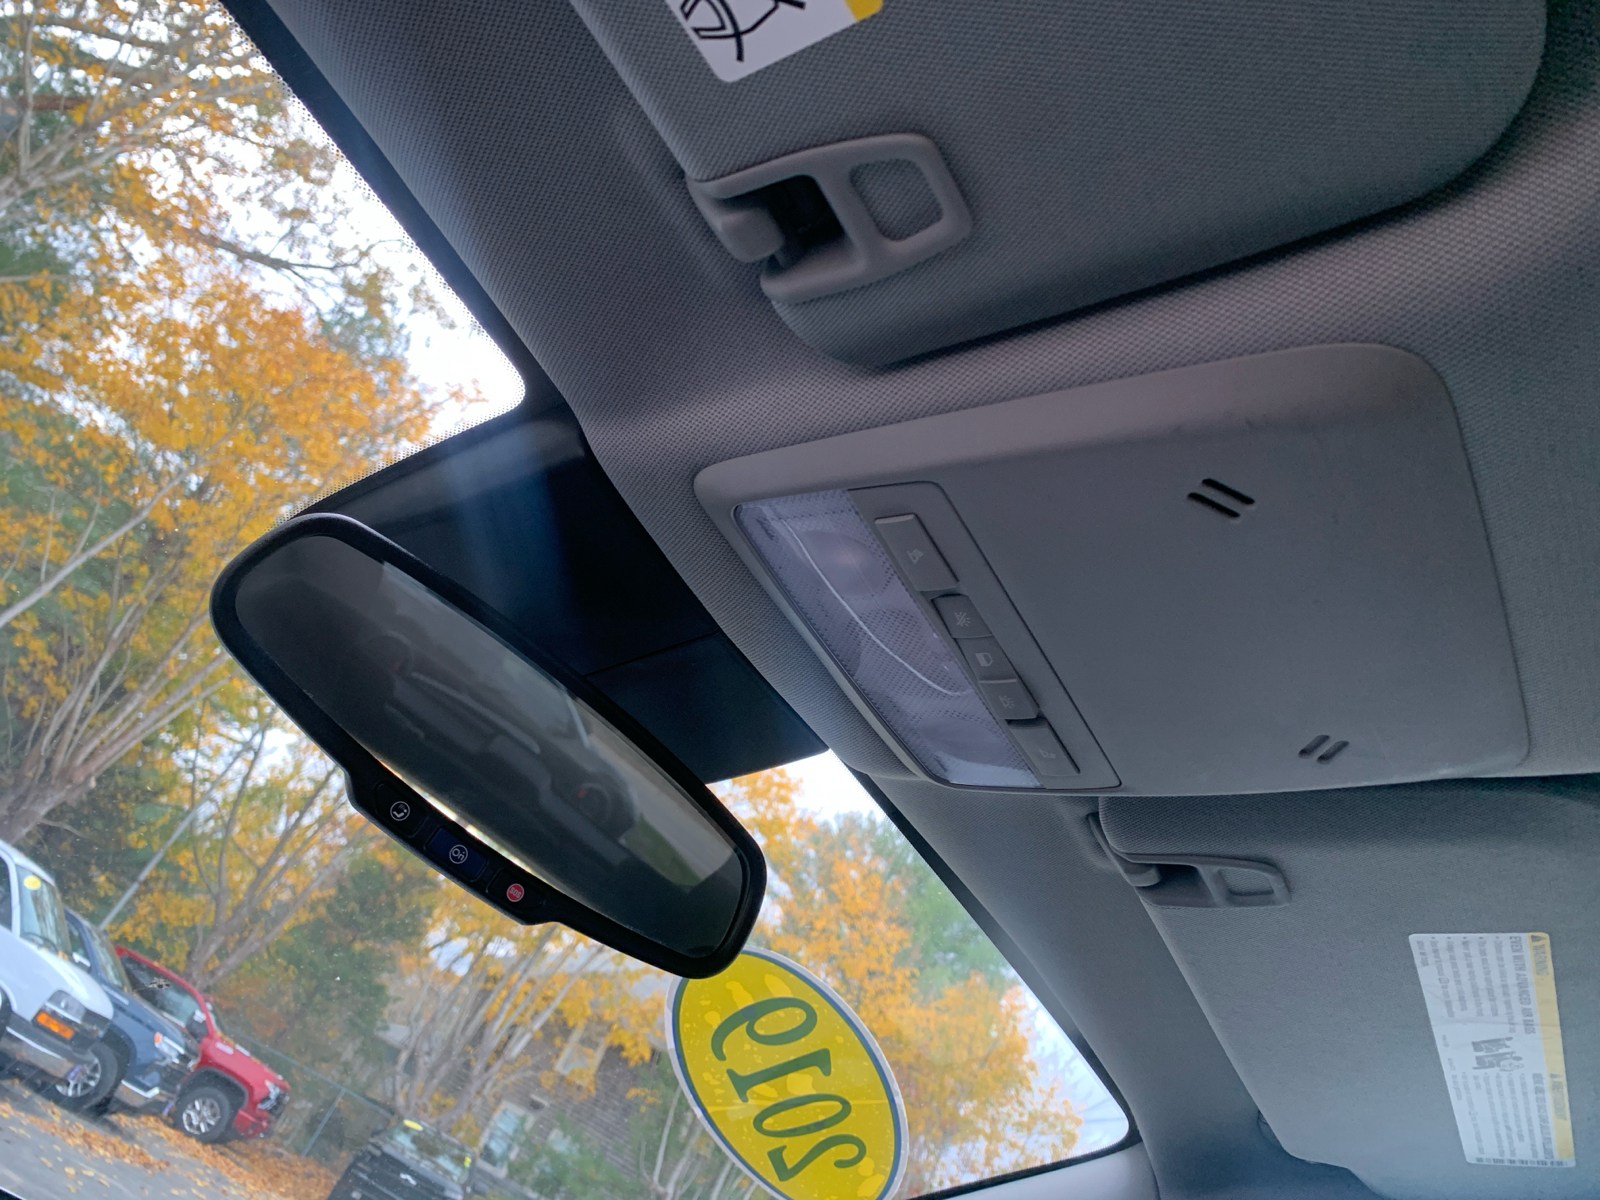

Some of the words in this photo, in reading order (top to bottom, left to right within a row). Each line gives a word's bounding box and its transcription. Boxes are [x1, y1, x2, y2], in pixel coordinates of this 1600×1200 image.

[509, 886, 522, 899] SOS
[1509, 936, 1523, 952] EVEN
[1512, 954, 1526, 971] WITH
[1531, 943, 1549, 975] WARNING
[1515, 972, 1531, 1005] ADVANCED
[1520, 1007, 1533, 1017] AIR
